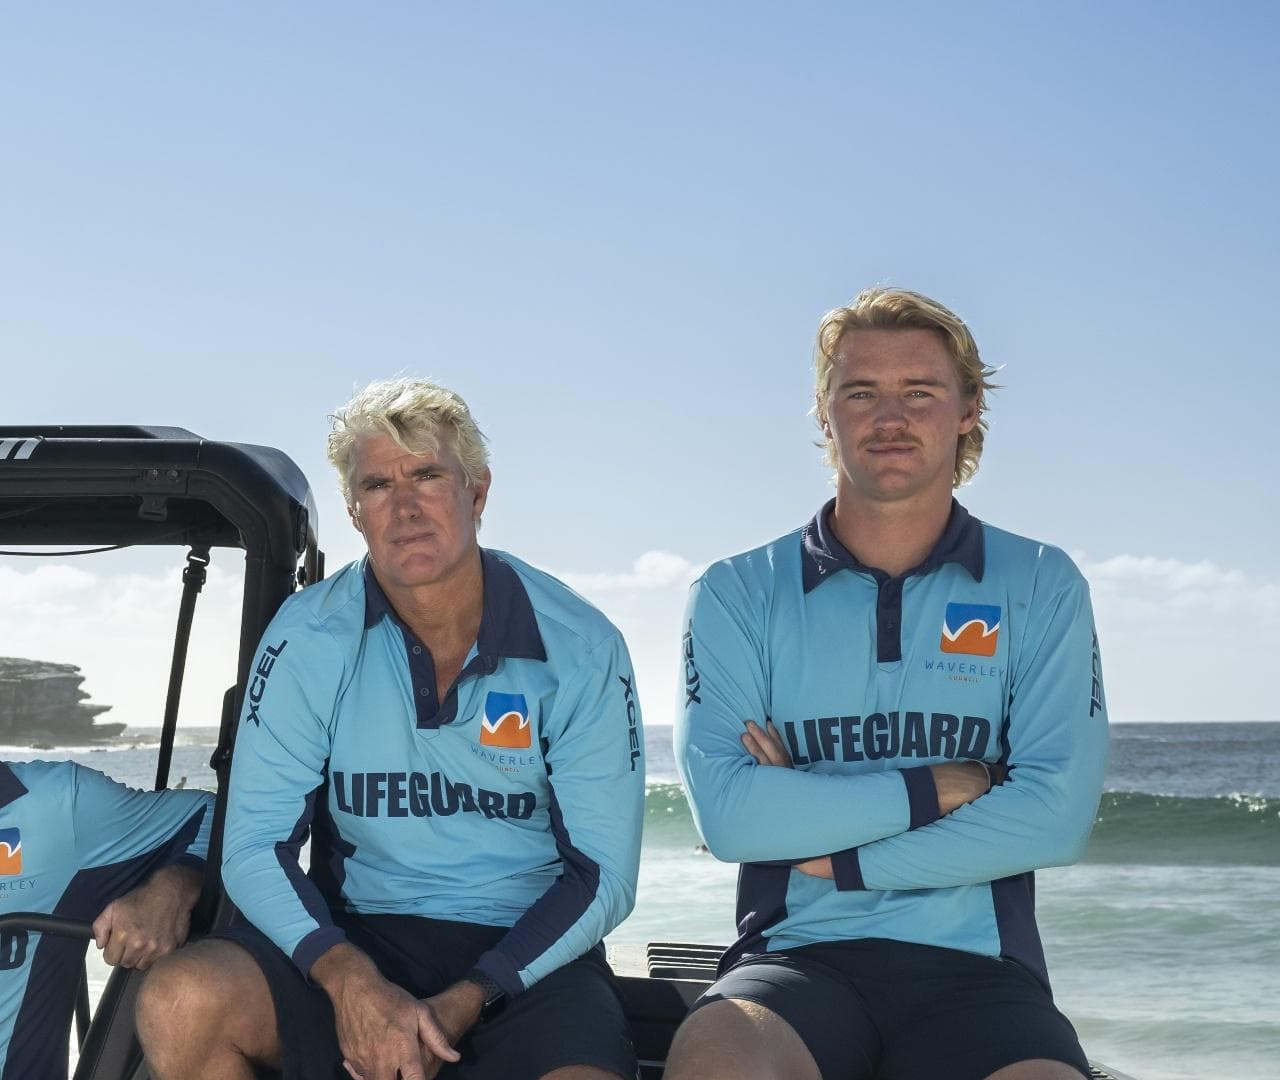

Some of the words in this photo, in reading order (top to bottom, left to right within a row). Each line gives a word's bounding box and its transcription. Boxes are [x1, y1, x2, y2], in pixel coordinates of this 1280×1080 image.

[246, 639, 288, 728] XCEL
[925, 659, 1004, 677] WAVERLEY
[618, 672, 640, 772] XCEL
[784, 711, 991, 766] LIFEGUARD
[470, 744, 537, 766] WAVERLE
[333, 771, 537, 820] LIFEGUARD
